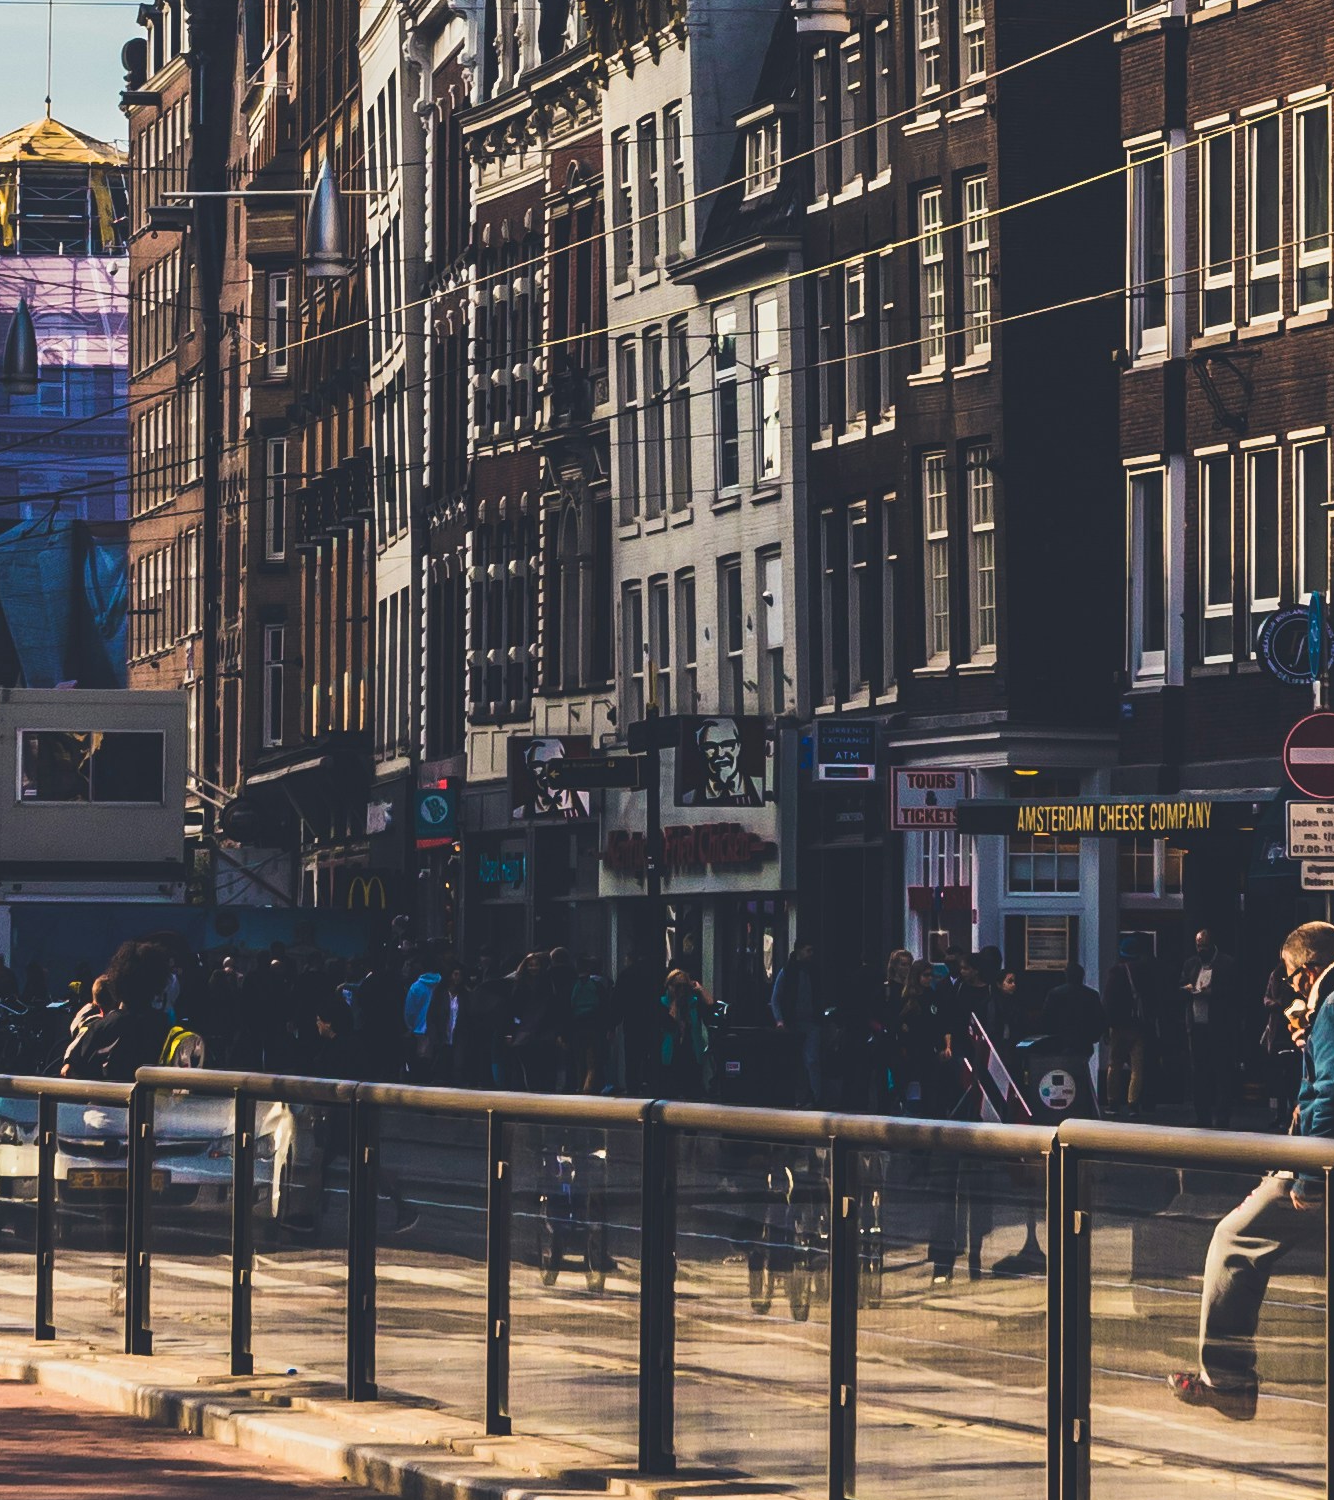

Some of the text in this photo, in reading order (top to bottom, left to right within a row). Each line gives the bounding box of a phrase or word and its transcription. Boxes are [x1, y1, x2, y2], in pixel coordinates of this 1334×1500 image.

[835, 751, 860, 760] ATM
[907, 774, 956, 789] TOURS
[1017, 801, 1212, 832] AMSTERDAM CHEESE COMPANY
[1293, 819, 1319, 827] laden
